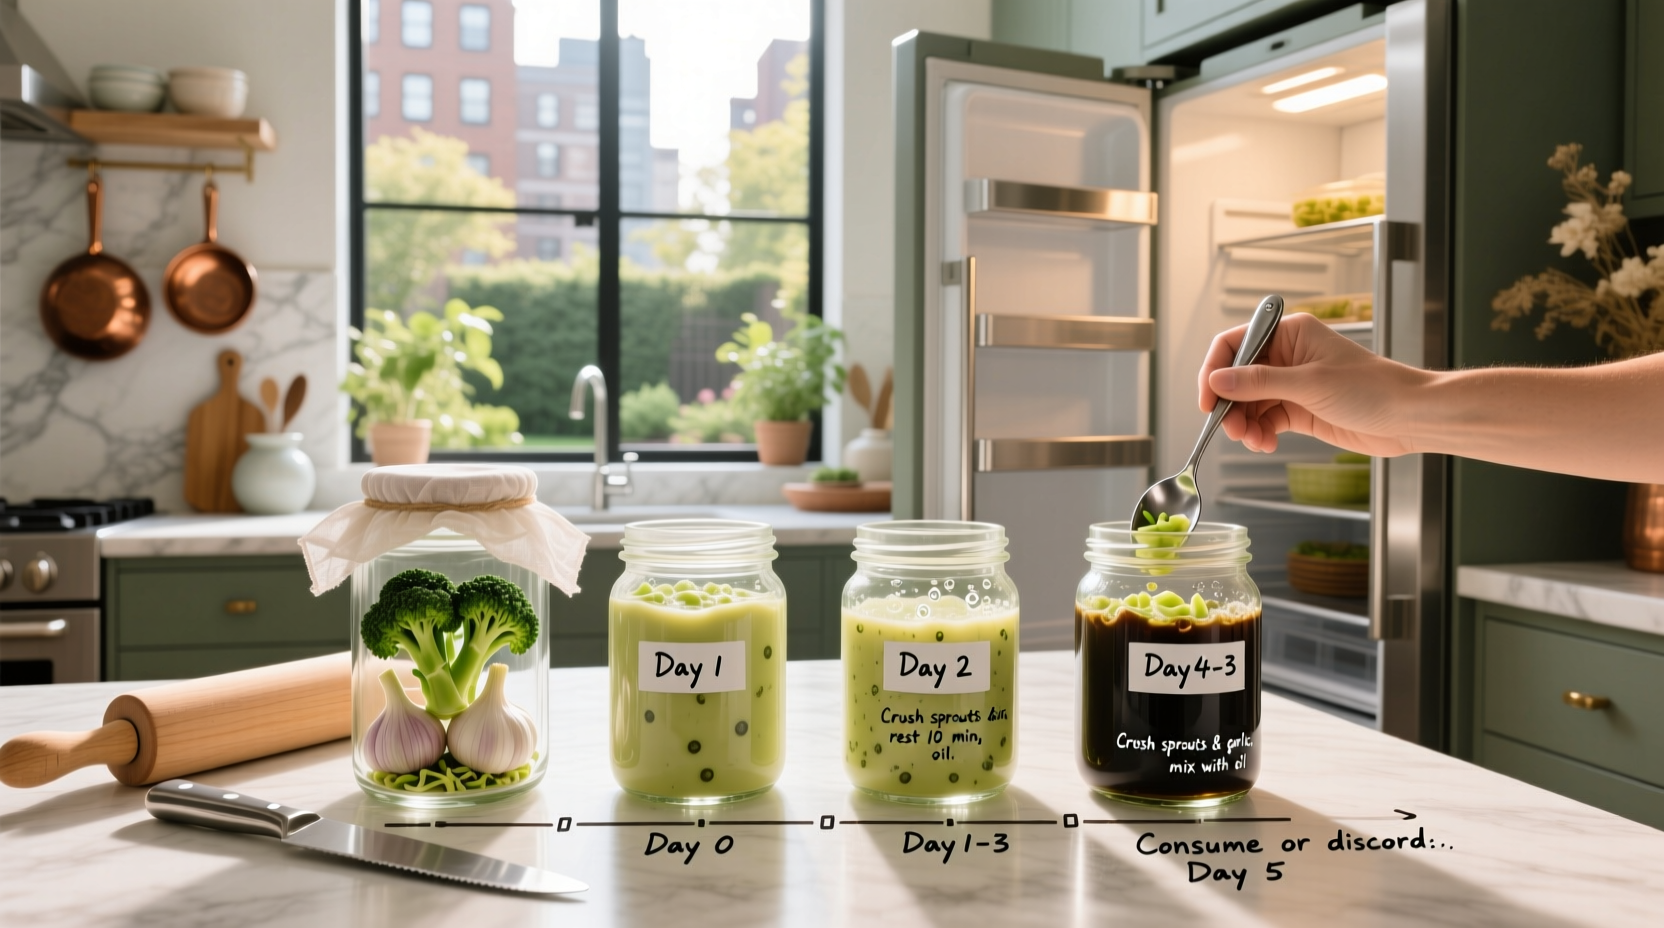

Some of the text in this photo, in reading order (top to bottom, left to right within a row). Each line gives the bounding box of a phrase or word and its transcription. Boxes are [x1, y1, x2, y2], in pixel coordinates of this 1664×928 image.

[655, 651, 723, 689] Day 1
[899, 651, 973, 689] Day 2
[881, 707, 924, 724] Crush
[930, 710, 981, 728] sprouts
[889, 729, 982, 745] rest 10 min,
[1161, 738, 1208, 757] sprouts
[1212, 734, 1221, 751] &
[932, 746, 954, 761] oil.
[1169, 759, 1196, 774] mix
[1201, 756, 1229, 773] with
[644, 832, 734, 865] Day 0
[902, 831, 955, 864] Day
[1136, 832, 1263, 855] Consume
[1281, 838, 1311, 853] or
[1187, 861, 1286, 890] Day 5
